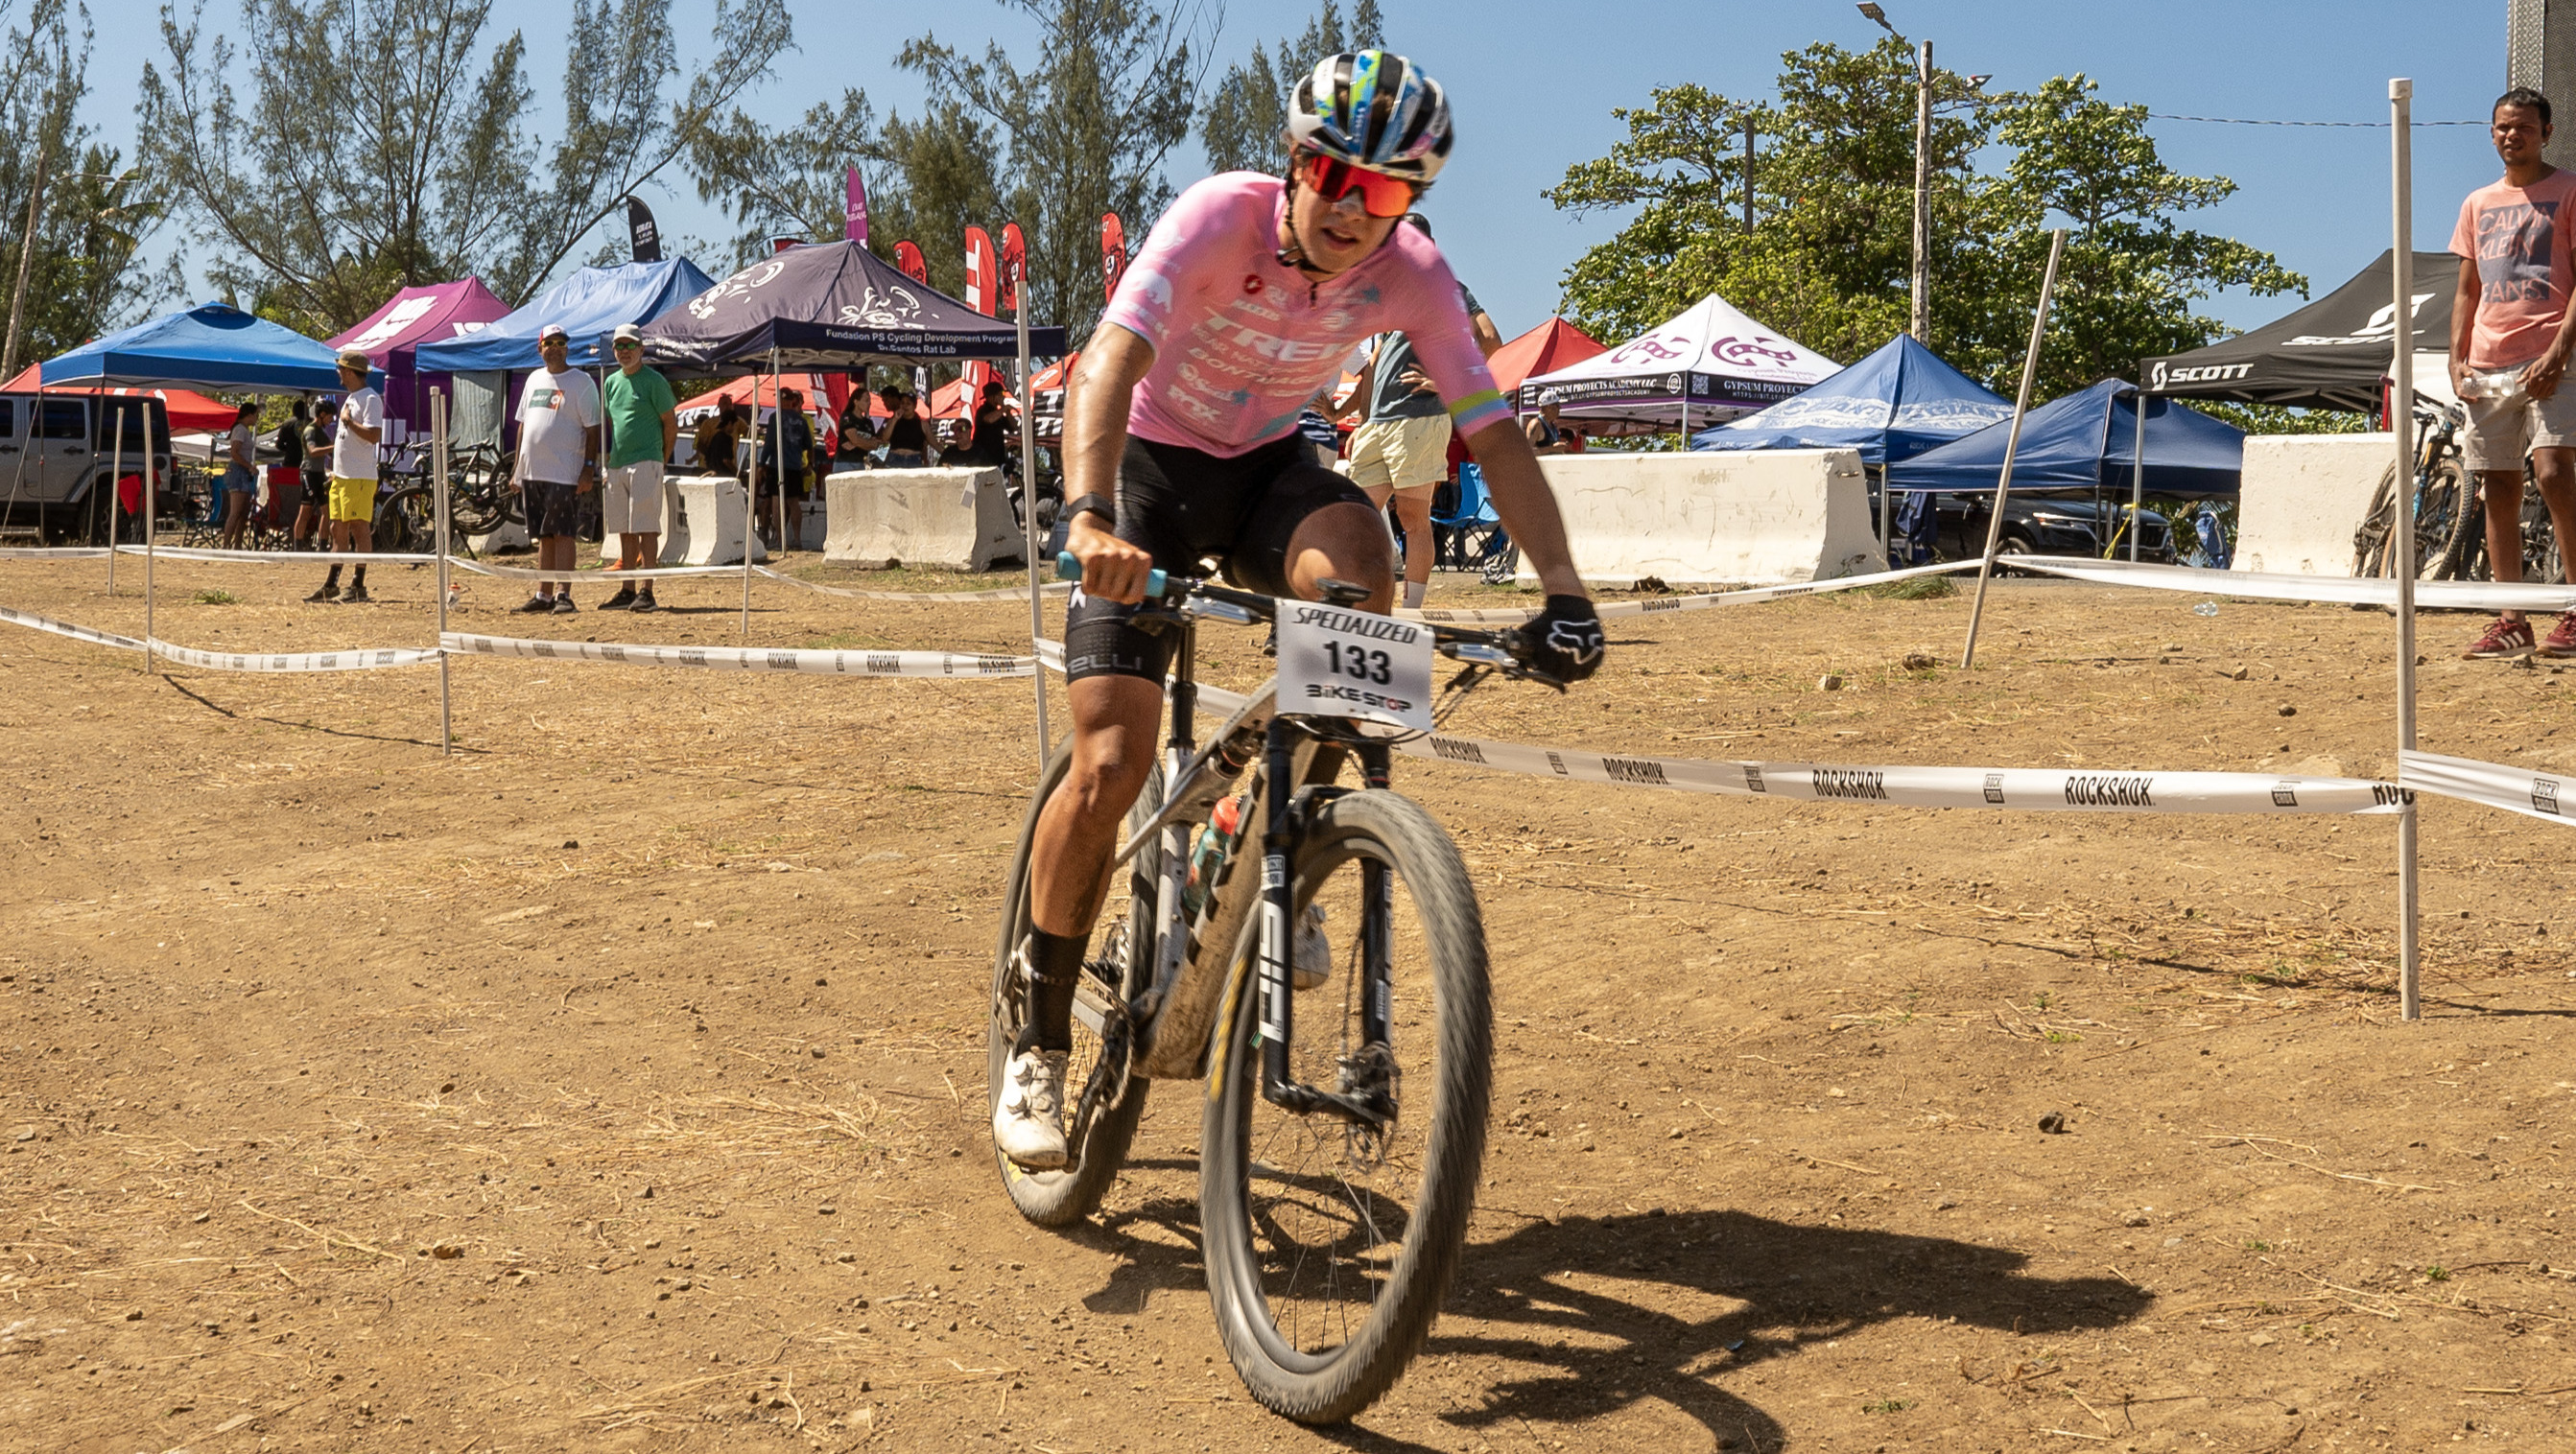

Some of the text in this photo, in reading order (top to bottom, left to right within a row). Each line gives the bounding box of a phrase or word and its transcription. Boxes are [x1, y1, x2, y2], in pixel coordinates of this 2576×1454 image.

[886, 332, 922, 344] Cycling
[924, 333, 981, 345] Development
[923, 344, 938, 354] Rat
[940, 344, 957, 354] Lab
[1723, 380, 1761, 391] GYPSUM
[2168, 363, 2255, 383] SCOTT
[1293, 606, 1418, 645] SPECIALIZED
[1323, 640, 1392, 686] 133
[1812, 768, 1888, 800] ROCKSHOX
[2065, 775, 2154, 807] ROCKSHOX
